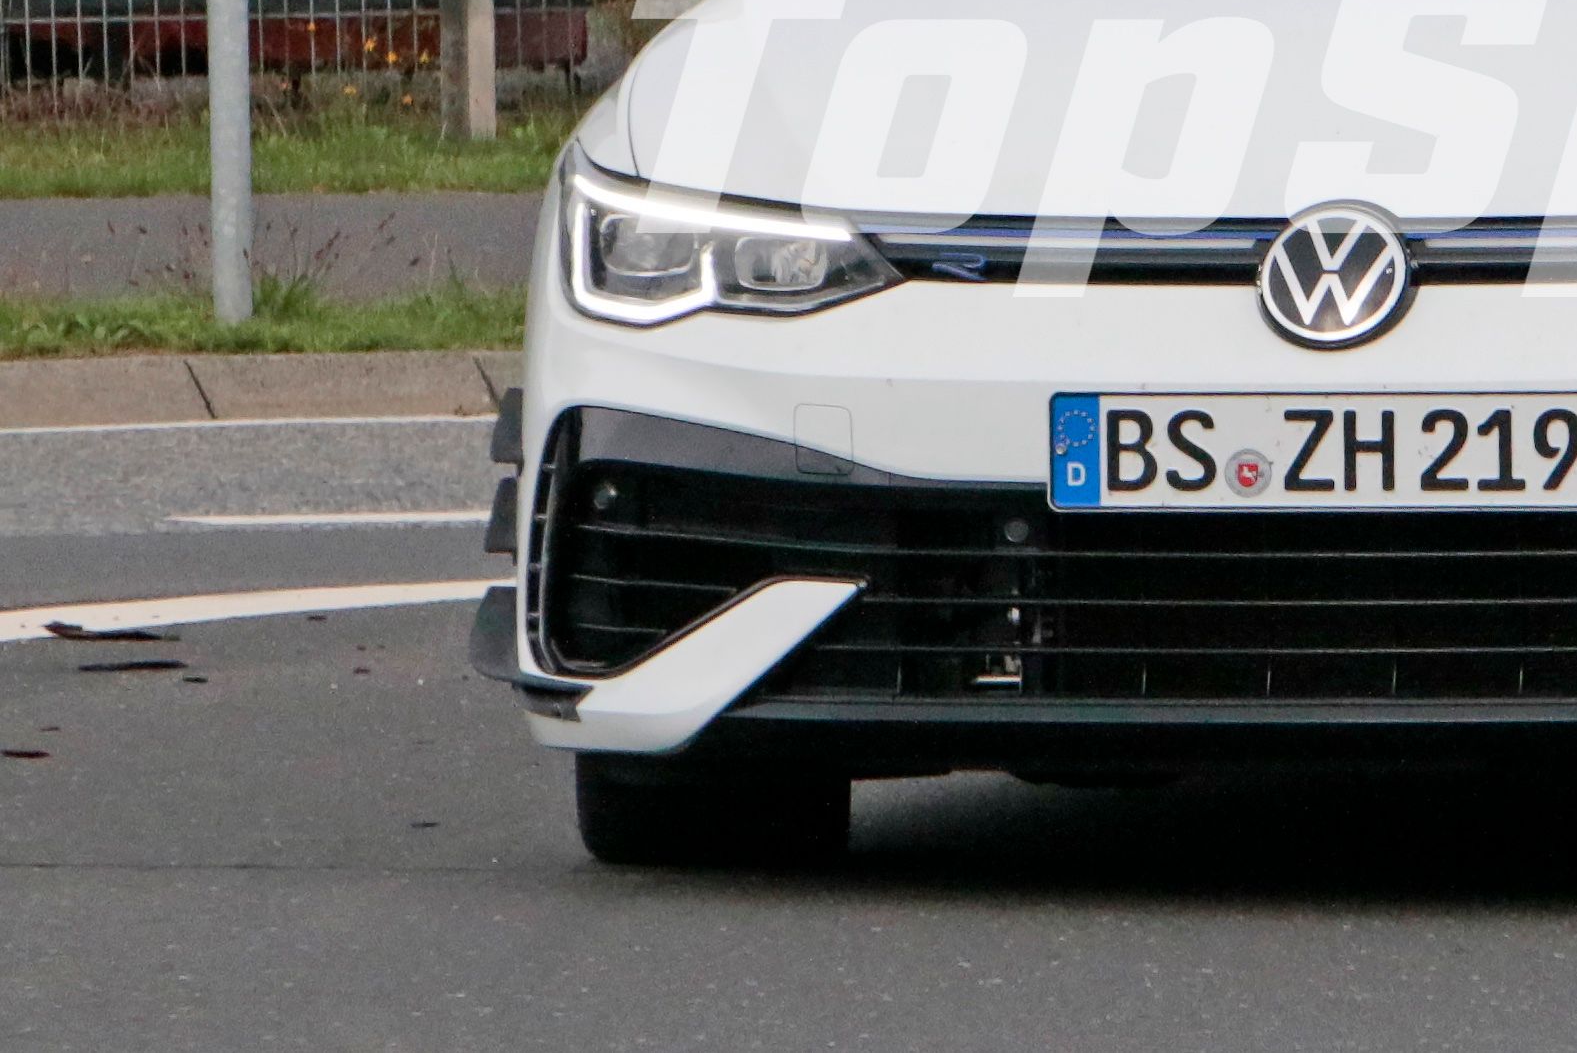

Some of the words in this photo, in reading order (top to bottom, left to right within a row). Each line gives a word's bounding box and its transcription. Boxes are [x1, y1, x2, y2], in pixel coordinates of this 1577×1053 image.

[1272, 214, 1400, 328] VW
[1066, 461, 1086, 487] D
[1105, 408, 1218, 493] BS
[1283, 409, 1396, 492] ZH
